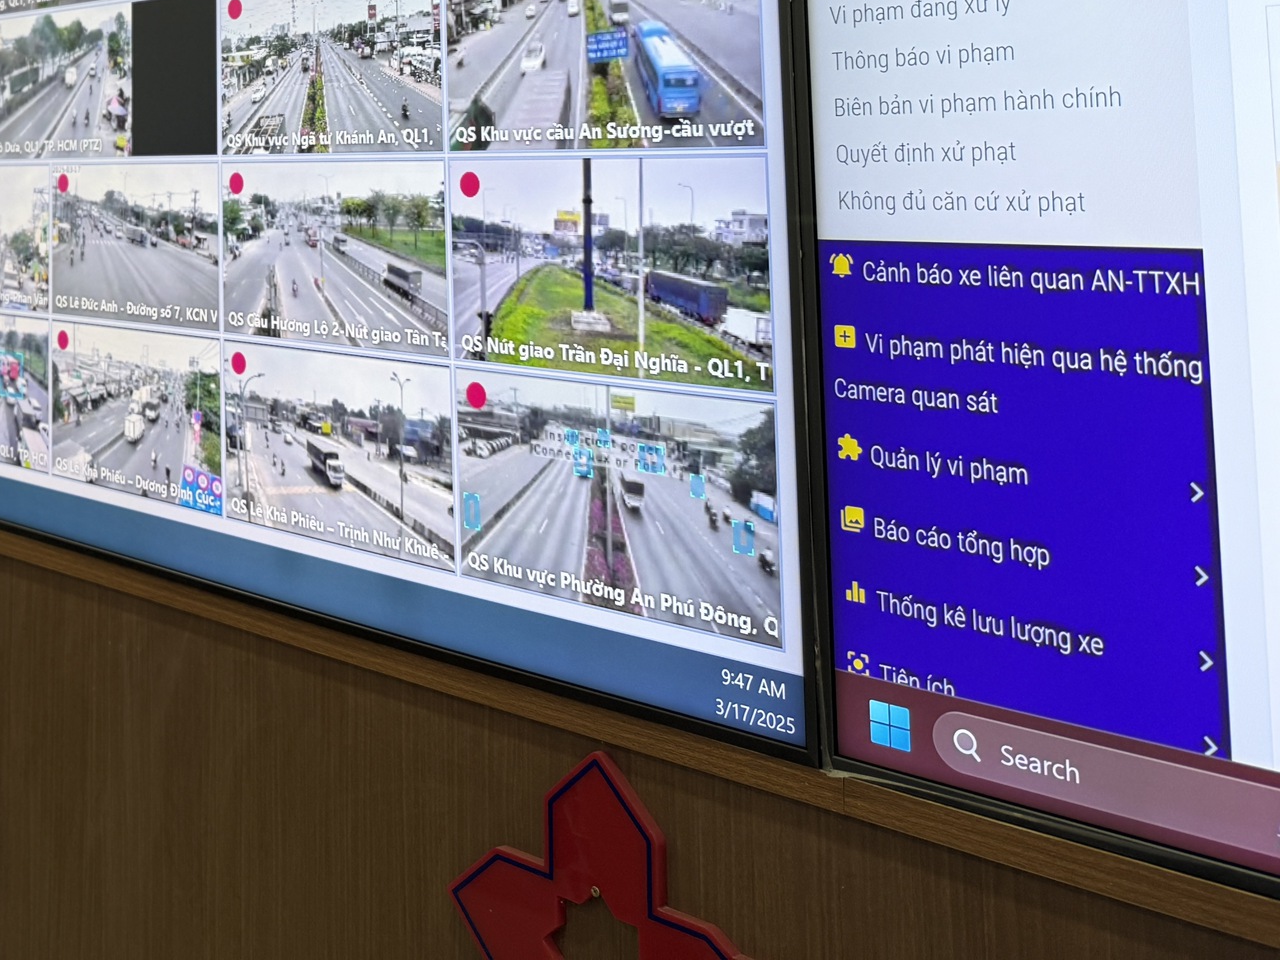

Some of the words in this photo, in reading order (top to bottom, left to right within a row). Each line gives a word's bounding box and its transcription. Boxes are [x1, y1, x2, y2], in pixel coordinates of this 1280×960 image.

[834, 97, 873, 117] Biên
[879, 94, 912, 115] bản
[919, 93, 934, 113] vi
[941, 90, 996, 117] phạm
[1003, 88, 1055, 111] hành
[1062, 86, 1121, 109] chính
[227, 135, 241, 147] QS
[245, 133, 266, 147] Khu
[269, 134, 288, 150] vực
[292, 133, 315, 150] Ngã
[319, 132, 332, 145] tư
[336, 130, 374, 145] Khánh
[377, 130, 399, 146] An,
[403, 128, 433, 145] QL1,
[455, 126, 476, 142] QS
[481, 126, 509, 141] Khu
[513, 127, 541, 144] vực
[546, 123, 574, 140] cầu
[579, 123, 602, 139] An
[606, 118, 703, 142] Sương-cầu
[708, 119, 754, 140] vượt
[838, 191, 896, 215] Không
[903, 190, 926, 211] đủ
[932, 191, 967, 211] căn
[974, 190, 1000, 211] cứ
[1006, 191, 1031, 211] xử
[1038, 190, 1085, 215] phạt
[862, 253, 910, 283] Cảnh
[917, 264, 953, 285] báo
[959, 270, 981, 286] xe
[987, 265, 1023, 288] liên
[1030, 272, 1084, 293] quan
[1091, 269, 1200, 296] AN-TTXH
[56, 295, 68, 307] QS
[70, 297, 79, 309] Lê
[81, 297, 98, 311] Đức
[101, 299, 118, 312] Anh
[127, 302, 158, 320] Đường
[160, 305, 172, 318] số
[174, 306, 183, 322] 7,
[186, 307, 207, 322] KCN
[229, 312, 244, 326] QS
[247, 313, 268, 328] Cầu
[271, 316, 310, 337] Hương
[314, 320, 328, 338] Lộ
[332, 320, 368, 340] 2-Nút
[372, 327, 401, 344] giao
[405, 329, 429, 346] Tân
[461, 335, 483, 352] QS
[487, 338, 515, 356] Nút
[519, 341, 554, 361] giao
[559, 343, 596, 363] Trần
[600, 348, 629, 369] Đại
[634, 351, 688, 374] Nghĩa
[707, 358, 751, 382] QL1,
[834, 378, 905, 405] Camera
[911, 387, 960, 411] quan
[966, 392, 998, 413] sát
[231, 498, 247, 513] QS
[250, 501, 263, 517] Lê
[266, 506, 287, 523] Khả
[291, 511, 324, 532] Phiêu
[337, 521, 369, 546] Trịnh
[373, 530, 402, 550] Như
[405, 538, 439, 559] Khuê
[874, 518, 910, 543] Báo
[916, 527, 951, 550] cáo
[958, 530, 1003, 563] tổng
[1011, 543, 1050, 570] hợp
[468, 552, 489, 570] QS
[493, 558, 522, 580] Khu
[527, 567, 555, 588] vực
[561, 572, 625, 606] Phường
[630, 588, 655, 608] An
[661, 593, 694, 618] Phú
[700, 602, 758, 635] Đông,
[876, 590, 937, 628] Thống
[943, 601, 966, 627] kê
[973, 609, 1004, 636] lưu
[1011, 617, 1071, 654] lượng
[1078, 633, 1104, 656] xe
[721, 669, 754, 692] 9:47
[758, 678, 786, 700] AM
[716, 699, 795, 734] 3/17/2025
[1001, 746, 1080, 784] Search
